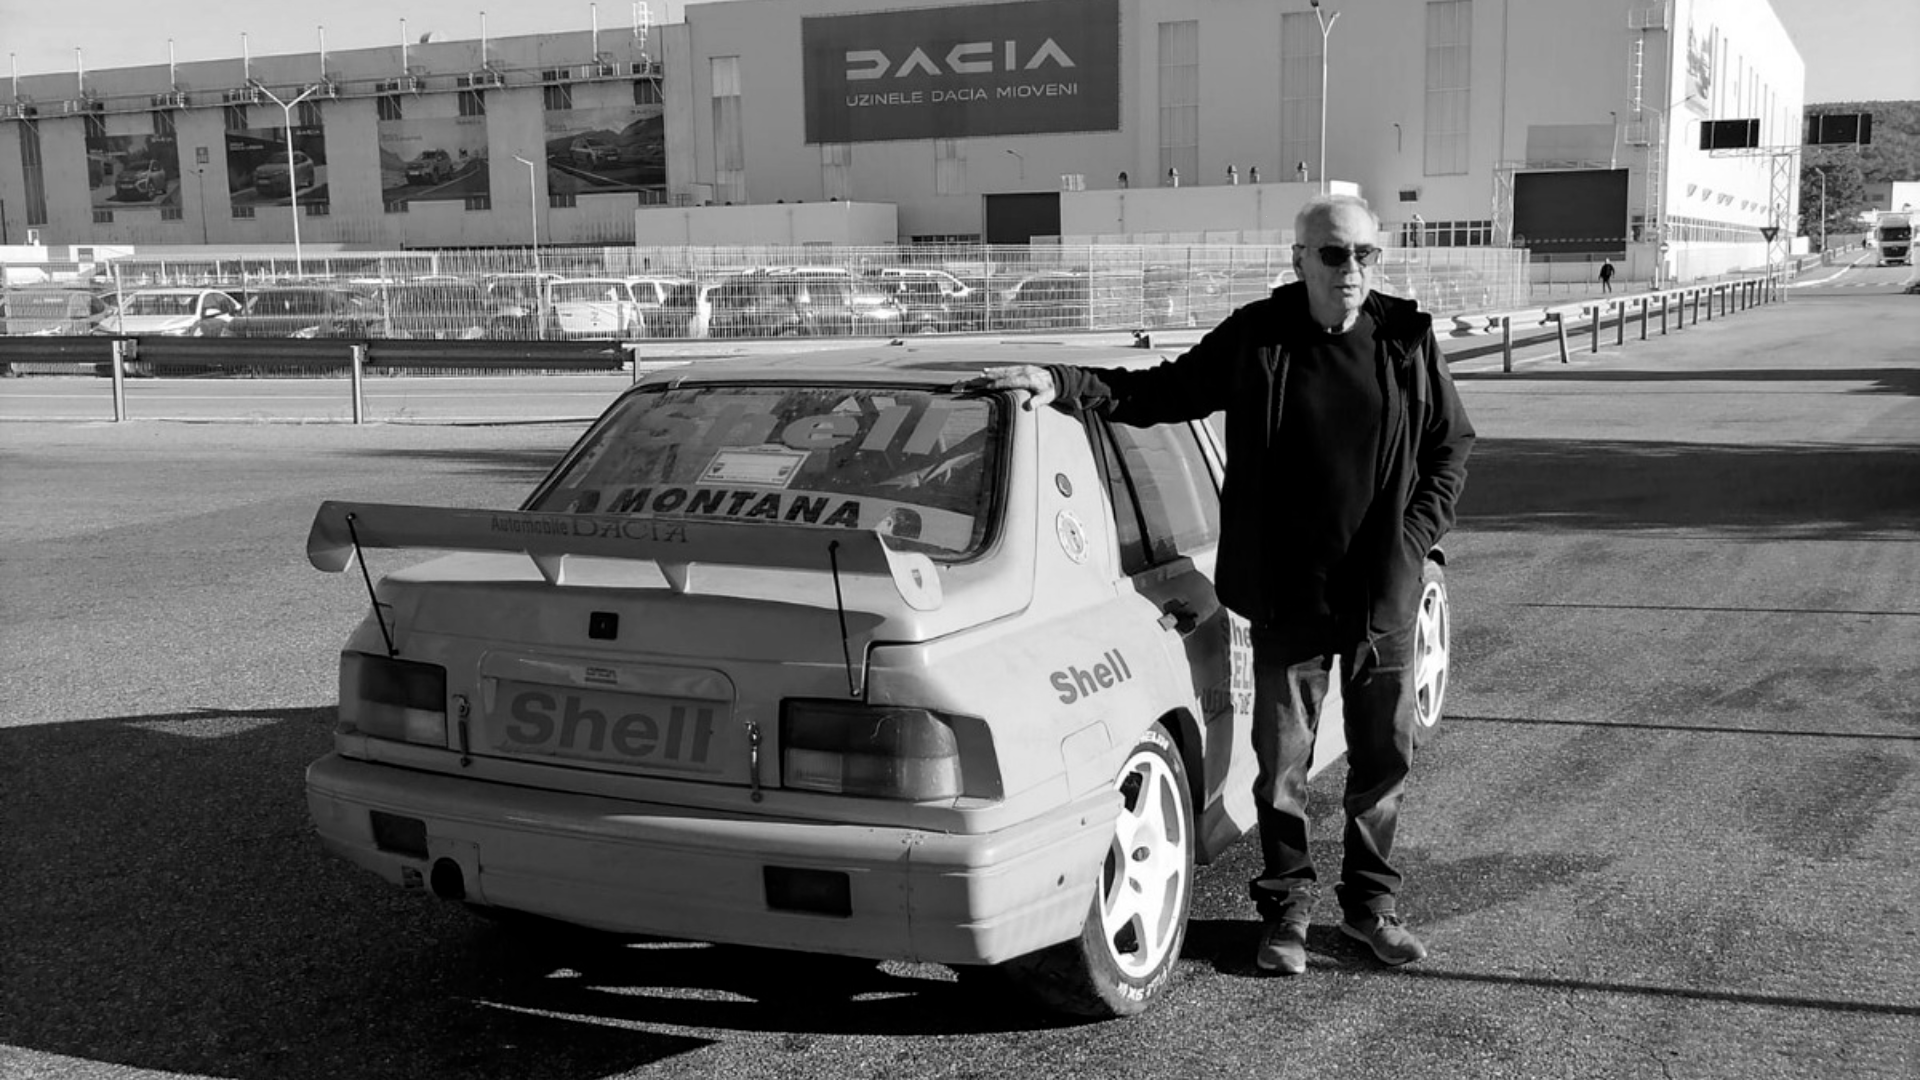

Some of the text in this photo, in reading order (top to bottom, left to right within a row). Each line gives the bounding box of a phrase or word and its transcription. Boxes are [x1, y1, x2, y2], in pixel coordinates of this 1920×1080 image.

[846, 37, 1077, 80] DACIA
[846, 82, 1078, 107] UZINELE DACIA MIOVENI
[490, 513, 690, 543] Automobile DACIA
[607, 488, 861, 528] MONTANA
[1049, 647, 1132, 705] Shell
[506, 691, 714, 763] Shell
